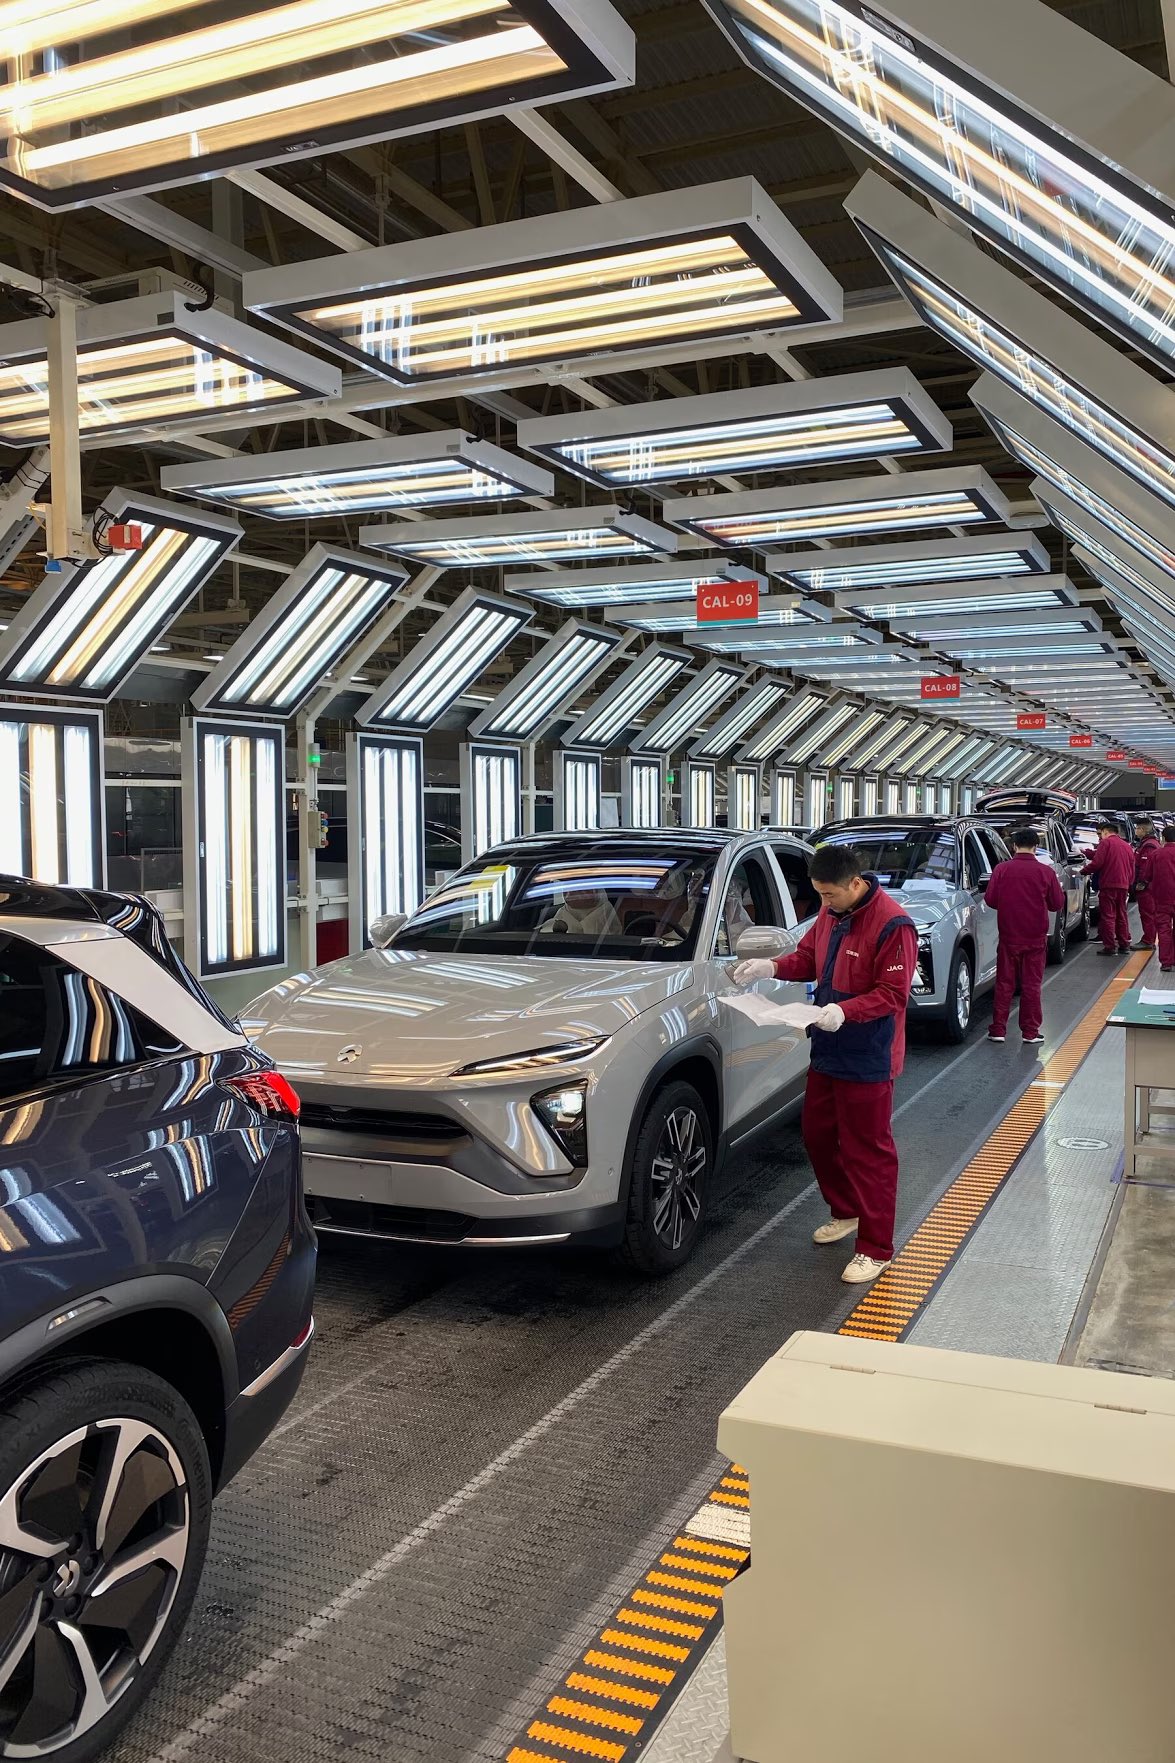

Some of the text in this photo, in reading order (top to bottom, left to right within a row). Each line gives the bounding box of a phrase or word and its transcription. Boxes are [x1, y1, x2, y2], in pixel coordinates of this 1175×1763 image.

[702, 593, 753, 609] CAL-09
[924, 683, 957, 692] CAL-08
[886, 964, 904, 972] JAC
